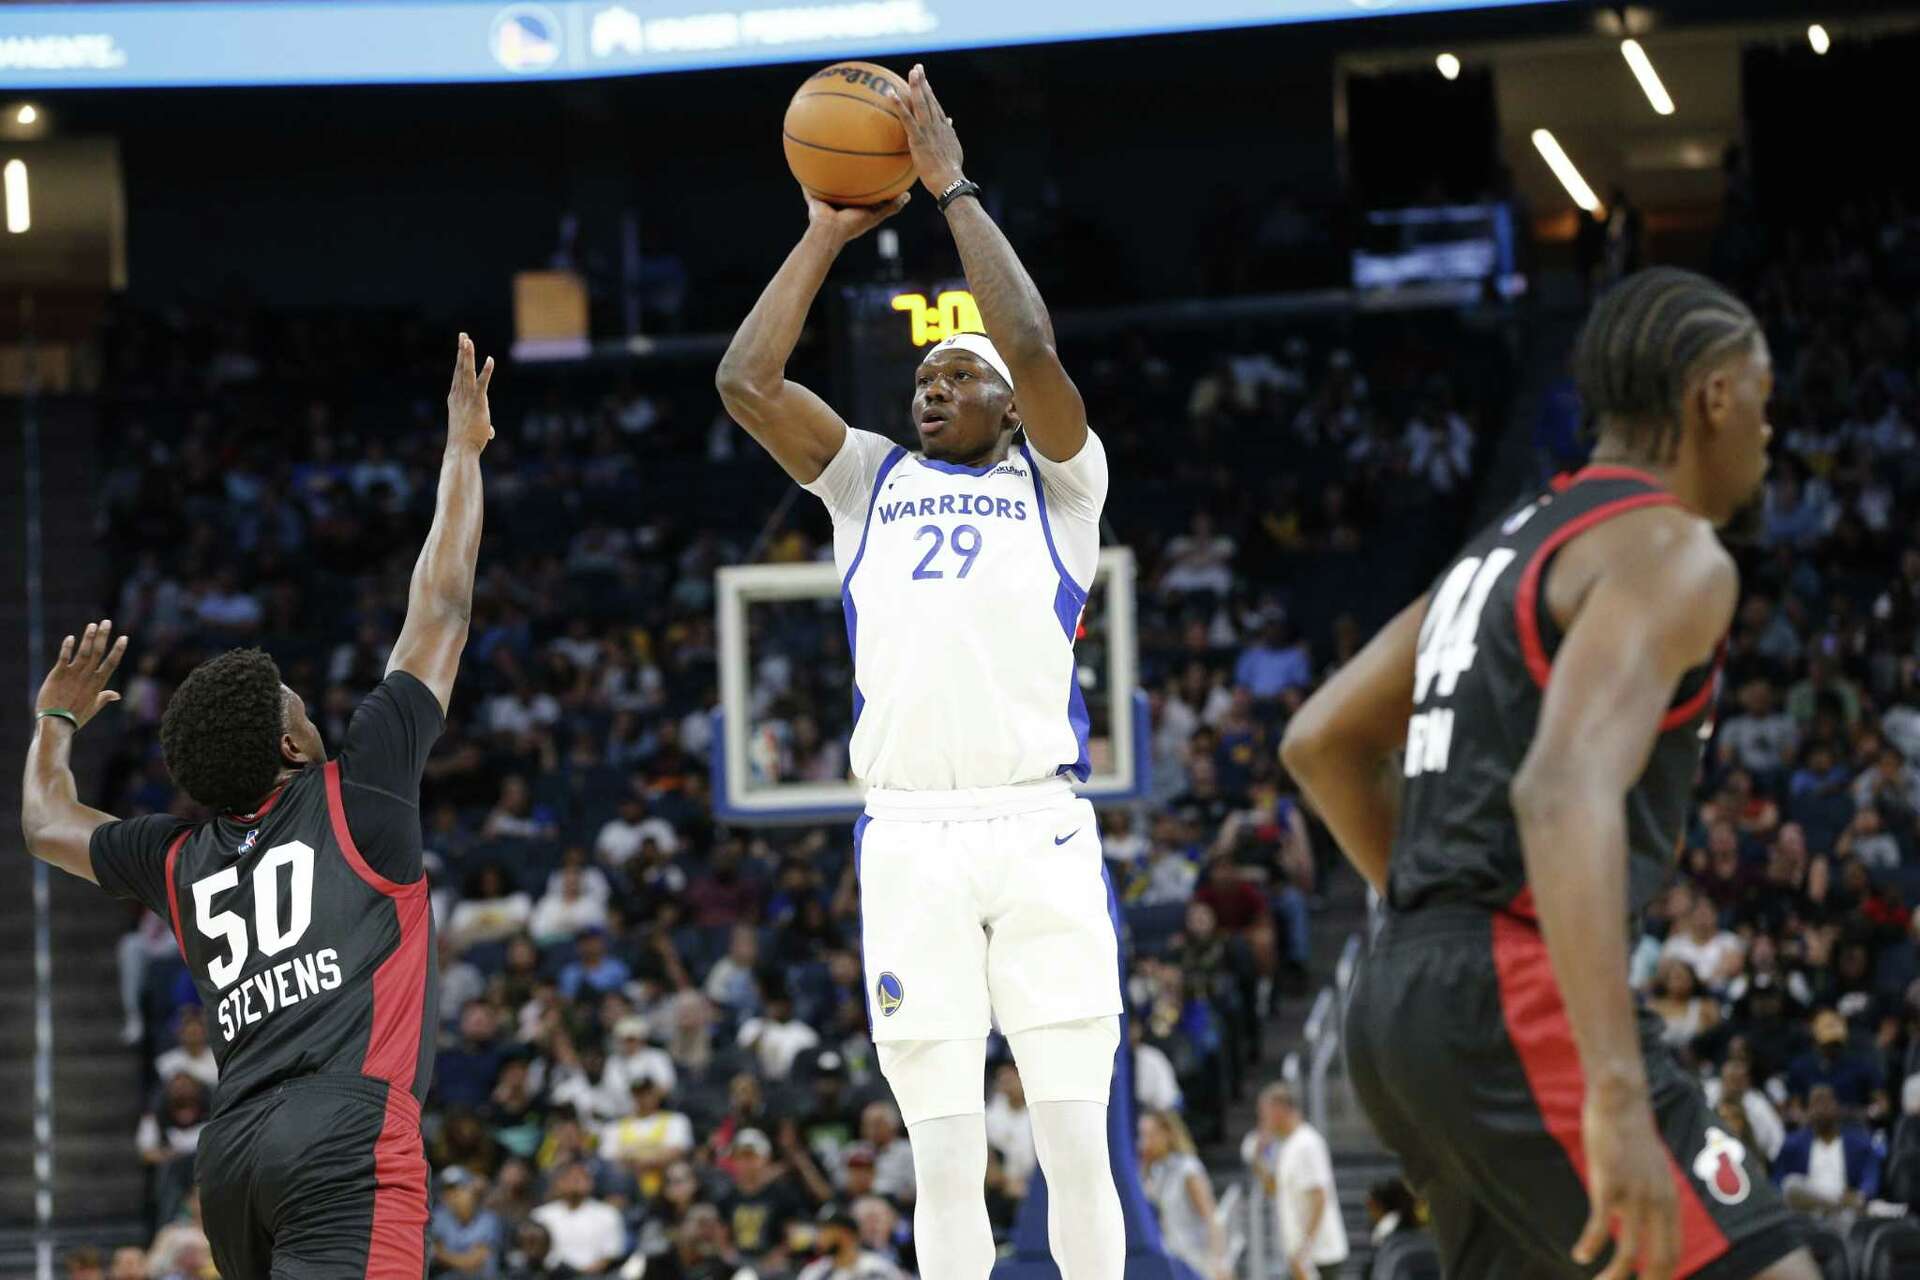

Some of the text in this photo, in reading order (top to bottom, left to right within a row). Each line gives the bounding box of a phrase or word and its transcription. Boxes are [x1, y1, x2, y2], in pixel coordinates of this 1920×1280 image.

[878, 493, 1027, 525] WARRIORS
[912, 524, 983, 581] 29
[1412, 547, 1517, 705] 44
[192, 840, 315, 991] 50
[217, 947, 342, 1042] STEVENS
